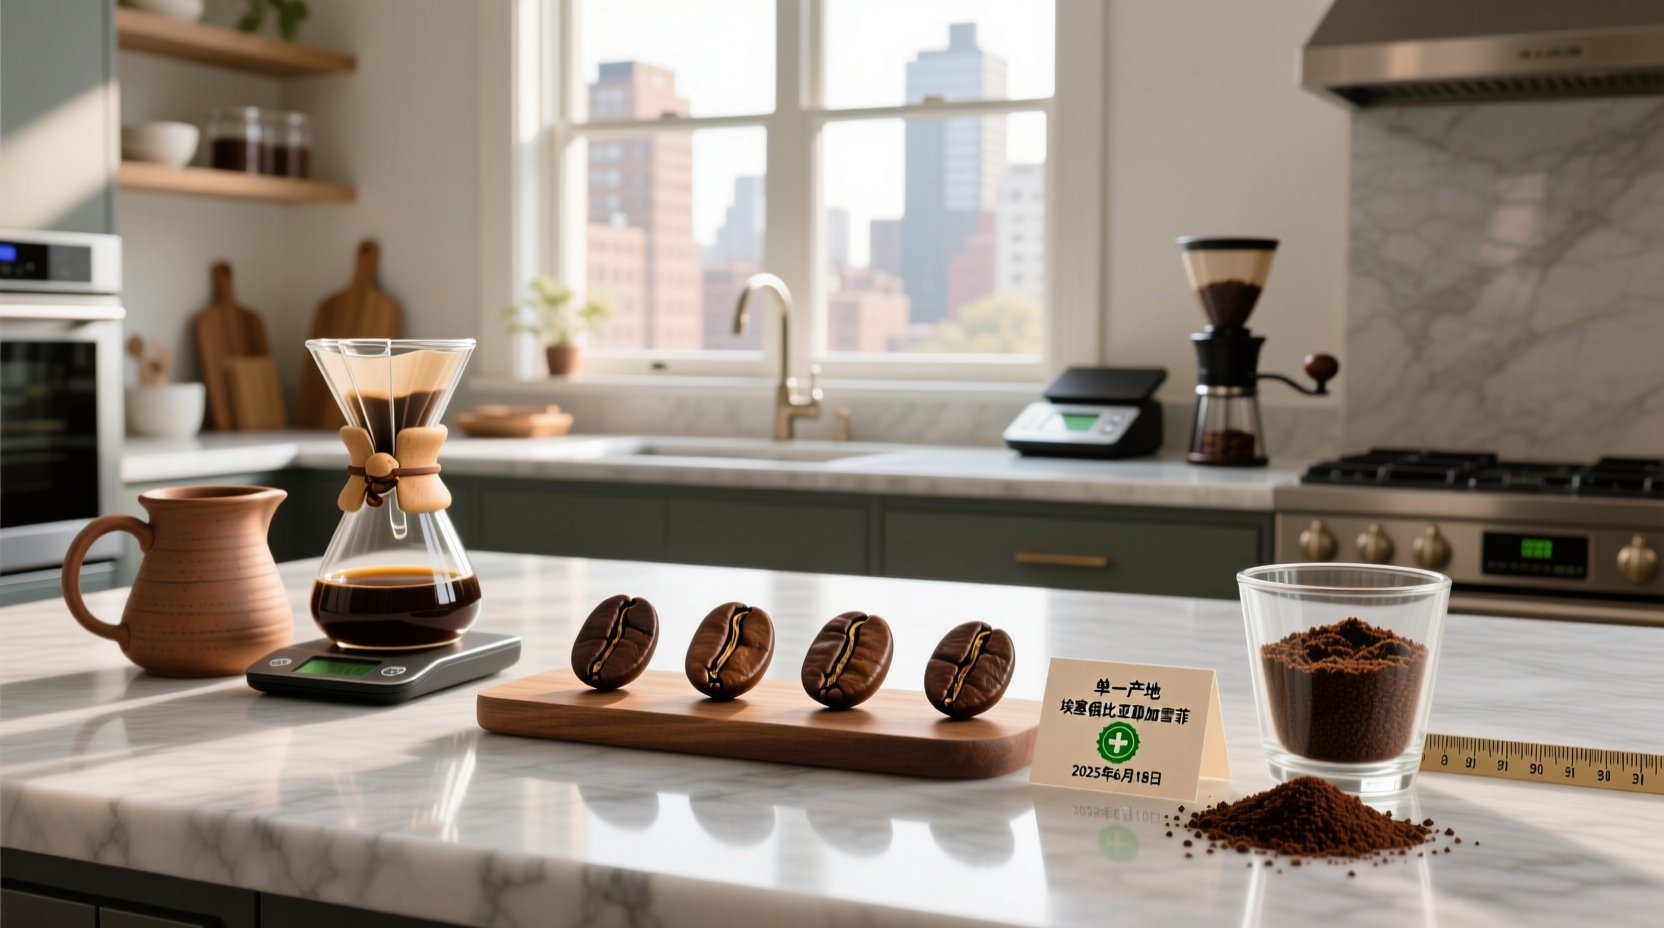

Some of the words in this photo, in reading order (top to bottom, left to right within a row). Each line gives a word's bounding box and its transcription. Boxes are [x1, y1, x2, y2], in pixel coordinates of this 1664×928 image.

[1093, 678, 1162, 700] 单一产地
[1071, 764, 1162, 786] 2025年6月18日
